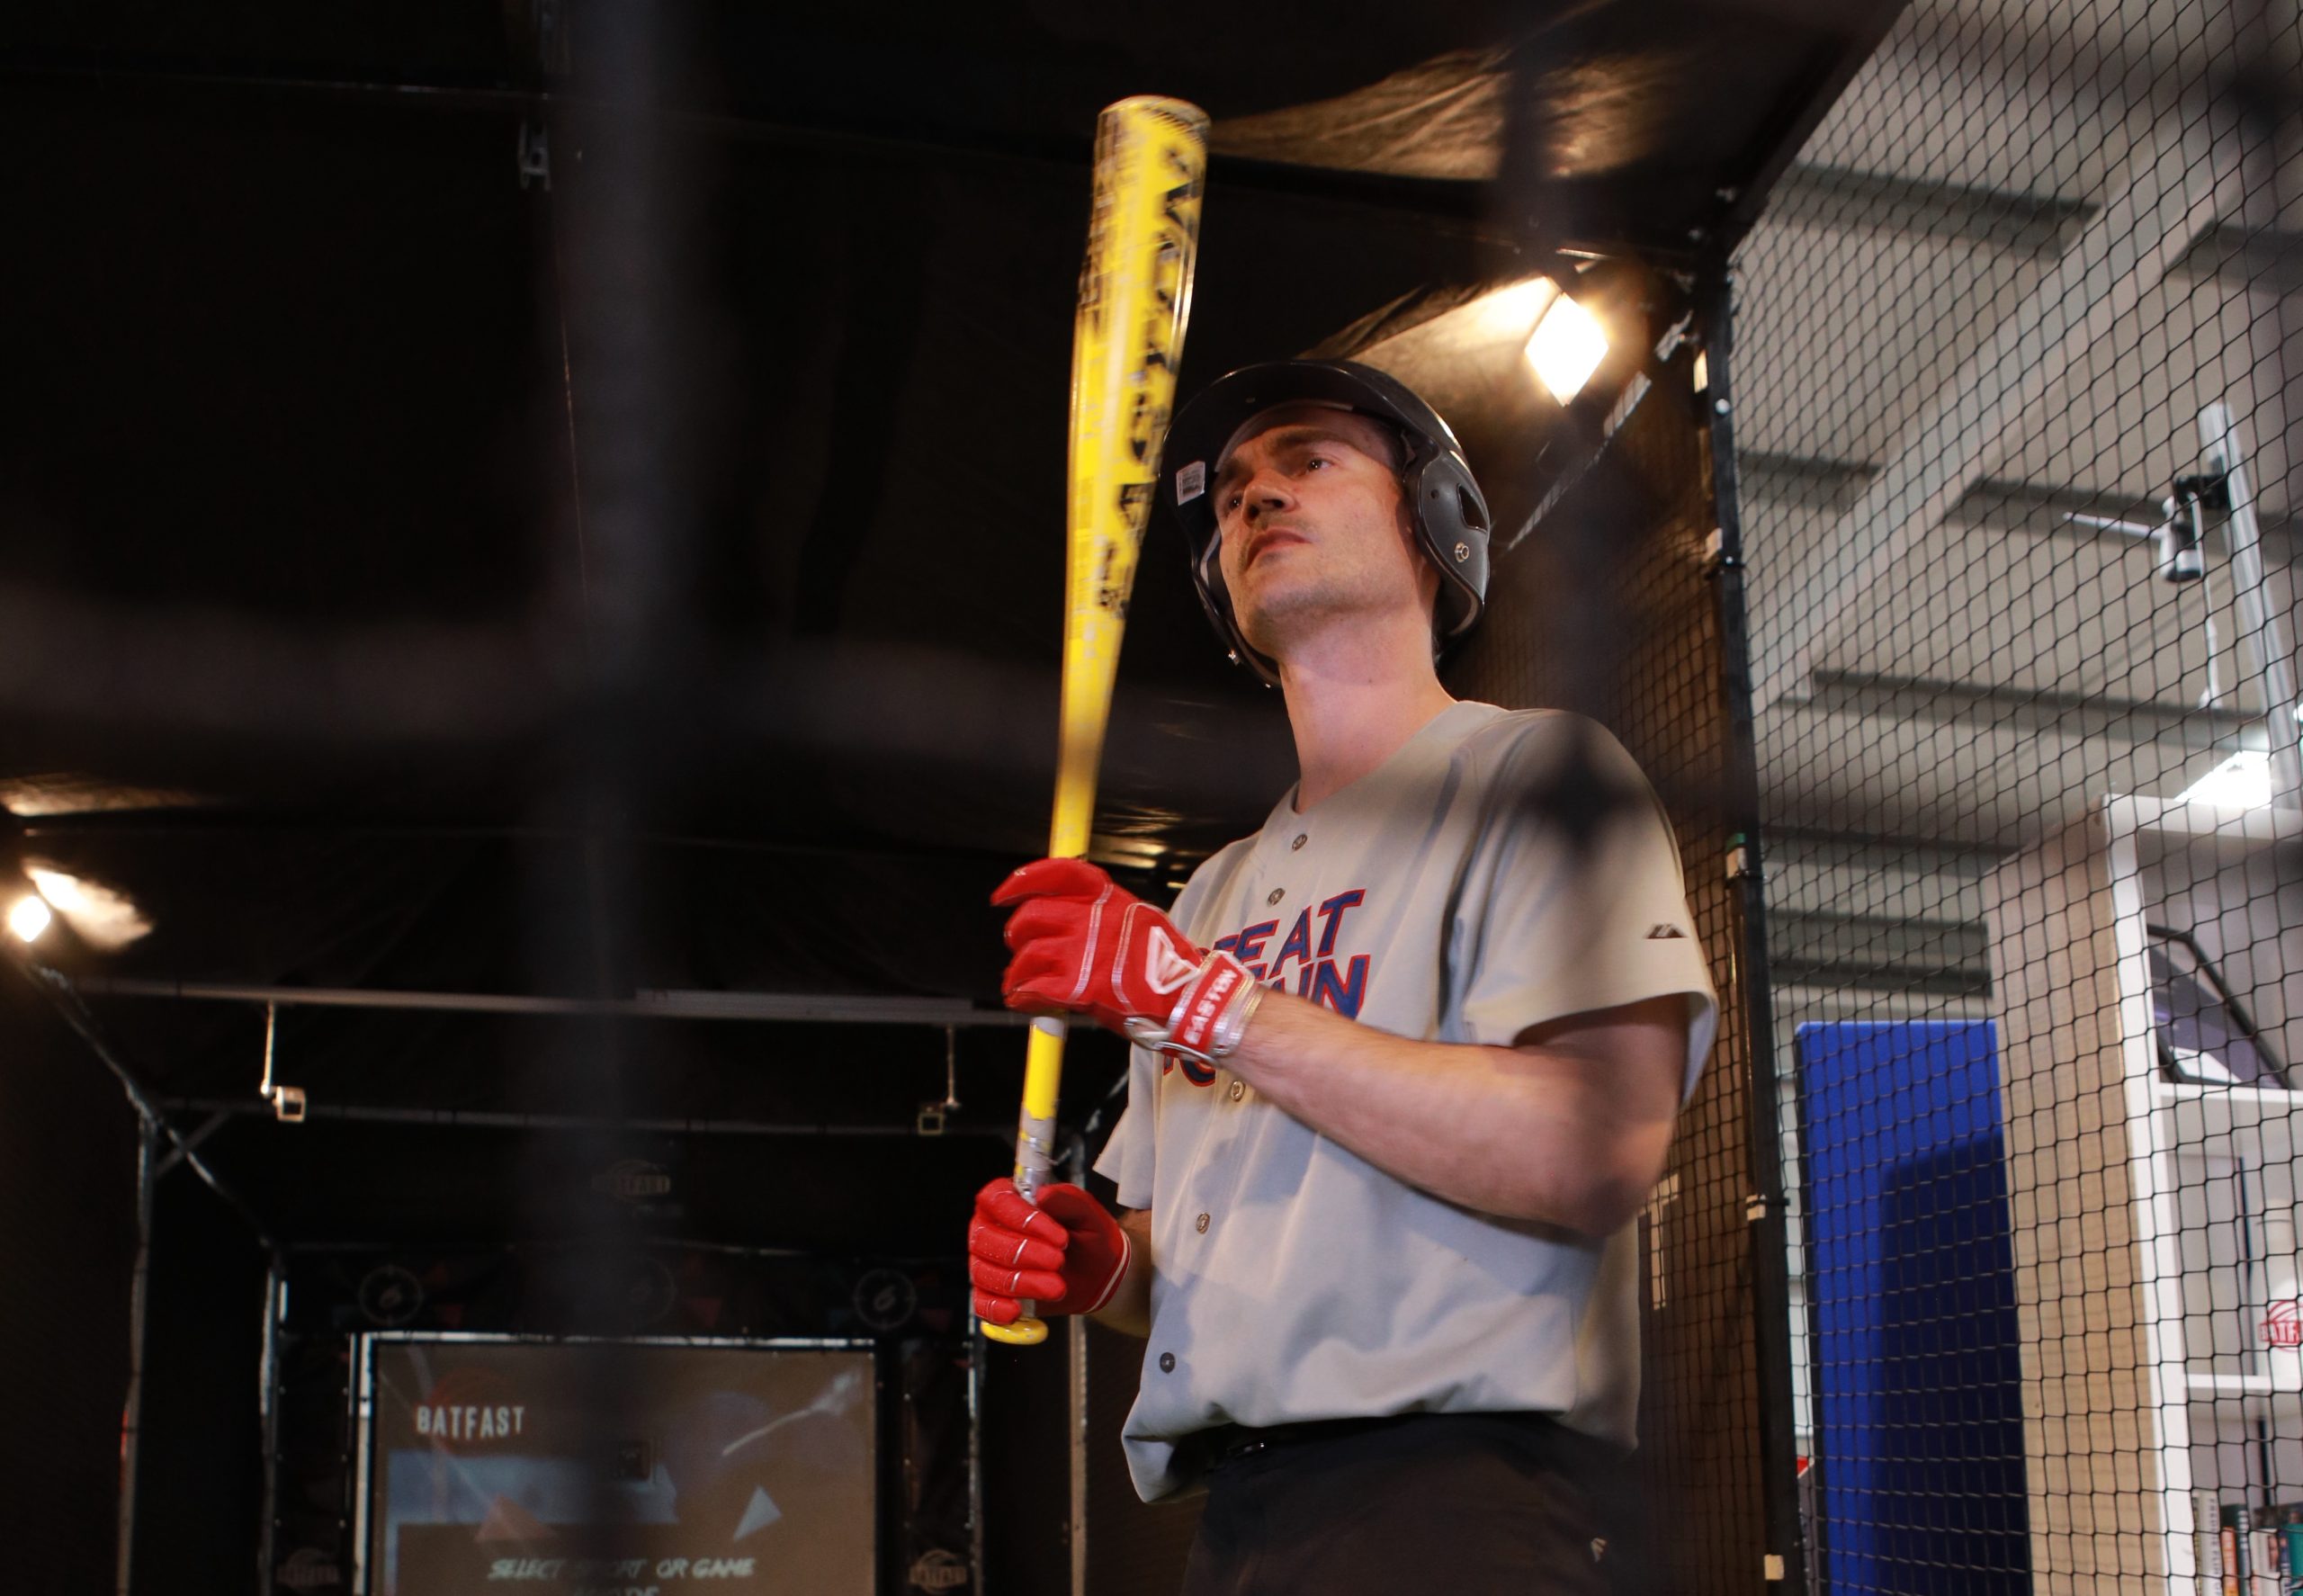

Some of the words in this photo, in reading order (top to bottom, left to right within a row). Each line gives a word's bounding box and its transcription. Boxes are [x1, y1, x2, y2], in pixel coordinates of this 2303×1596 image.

[1183, 967, 1239, 1045] EASTON
[417, 1404, 524, 1440] BATFAST
[487, 1557, 567, 1580] SELECT
[656, 1557, 689, 1579] OR
[692, 1557, 757, 1579] GAME
